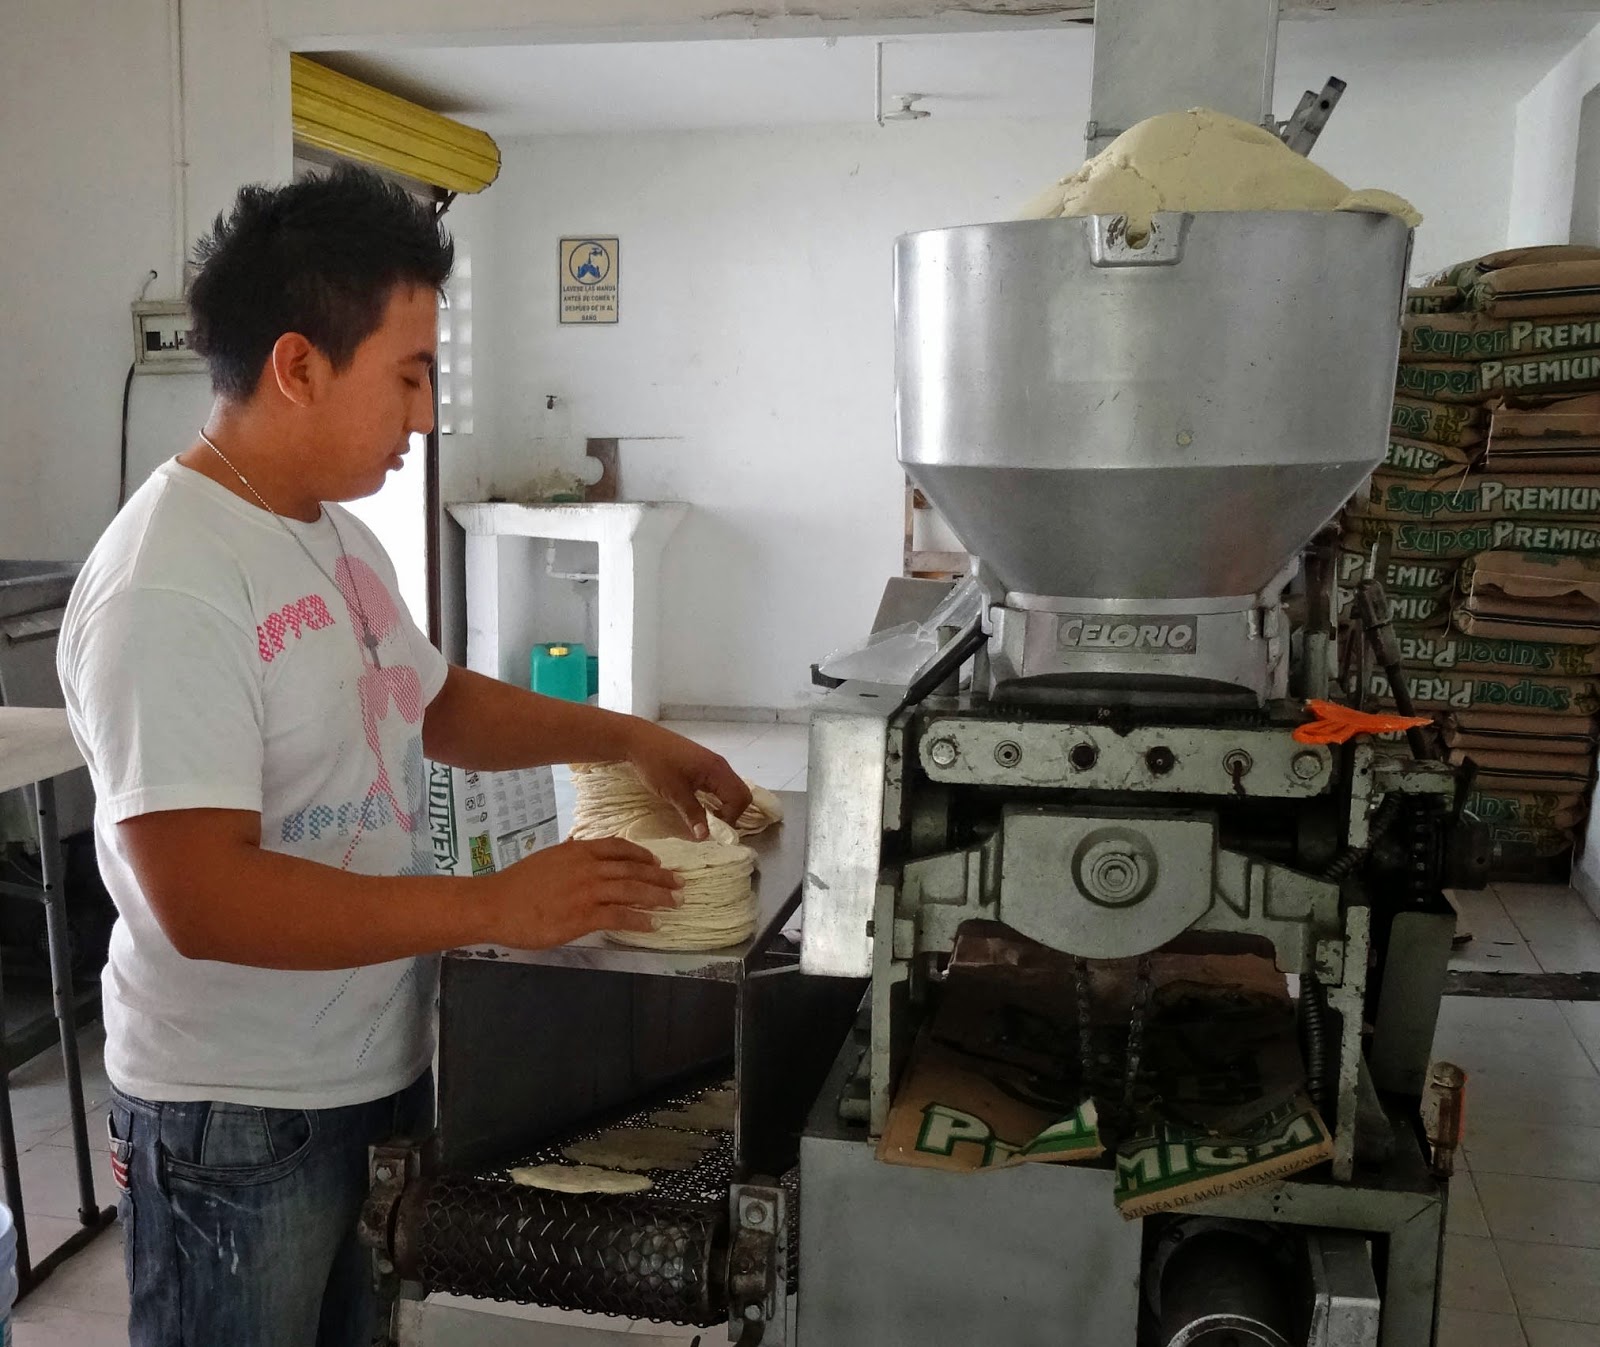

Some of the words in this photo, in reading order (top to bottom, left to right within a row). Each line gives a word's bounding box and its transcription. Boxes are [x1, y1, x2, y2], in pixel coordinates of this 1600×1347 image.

[1412, 325, 1508, 357] Super
[1387, 484, 1479, 518] Super
[1399, 522, 1492, 555] Super
[1059, 619, 1192, 648] CELORIO
[1457, 639, 1556, 671] Super
[1476, 680, 1572, 711] Super
[1174, 1194, 1192, 1207] DE
